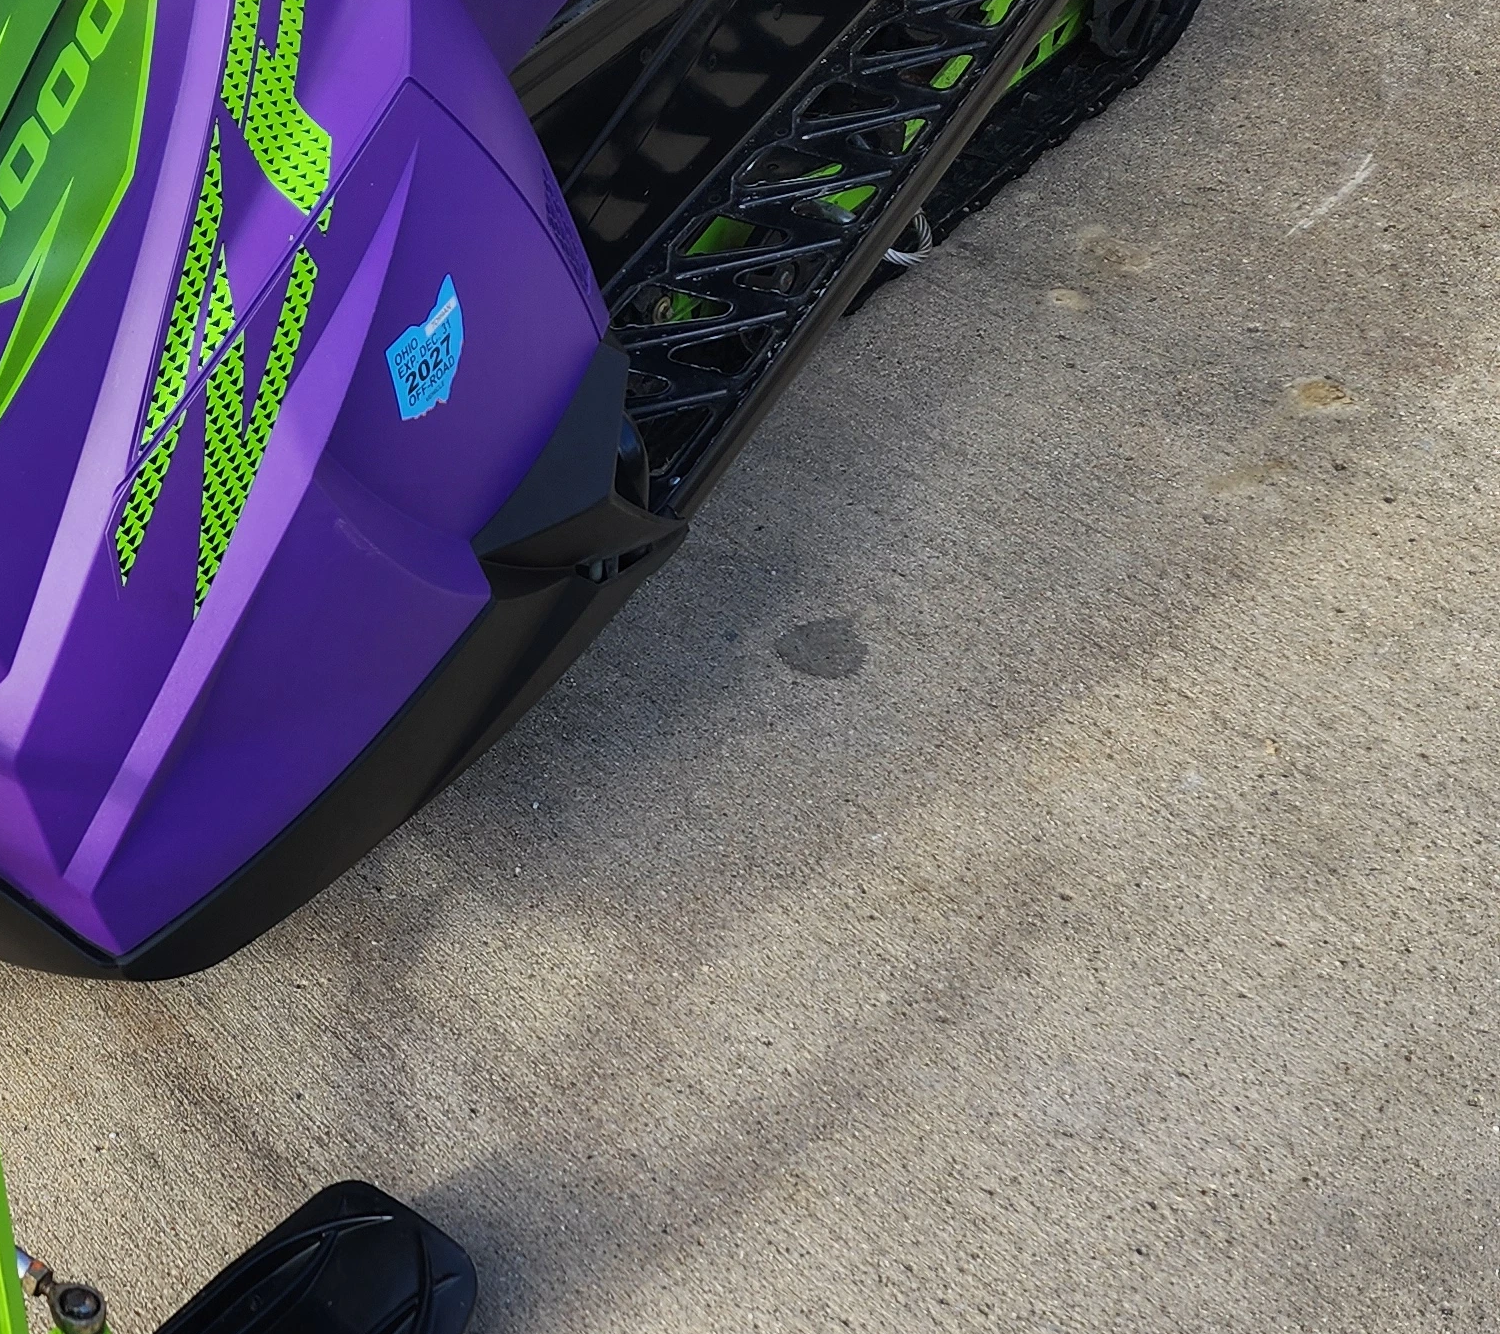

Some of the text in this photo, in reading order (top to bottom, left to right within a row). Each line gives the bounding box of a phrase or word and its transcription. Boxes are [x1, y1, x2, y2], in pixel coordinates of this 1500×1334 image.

[394, 338, 419, 366] OHIO
[398, 355, 419, 379] EXP.
[419, 333, 442, 357] DEC.
[442, 319, 452, 334] 31
[404, 333, 451, 396] 2027
[408, 355, 455, 407] OFF-ROAD
